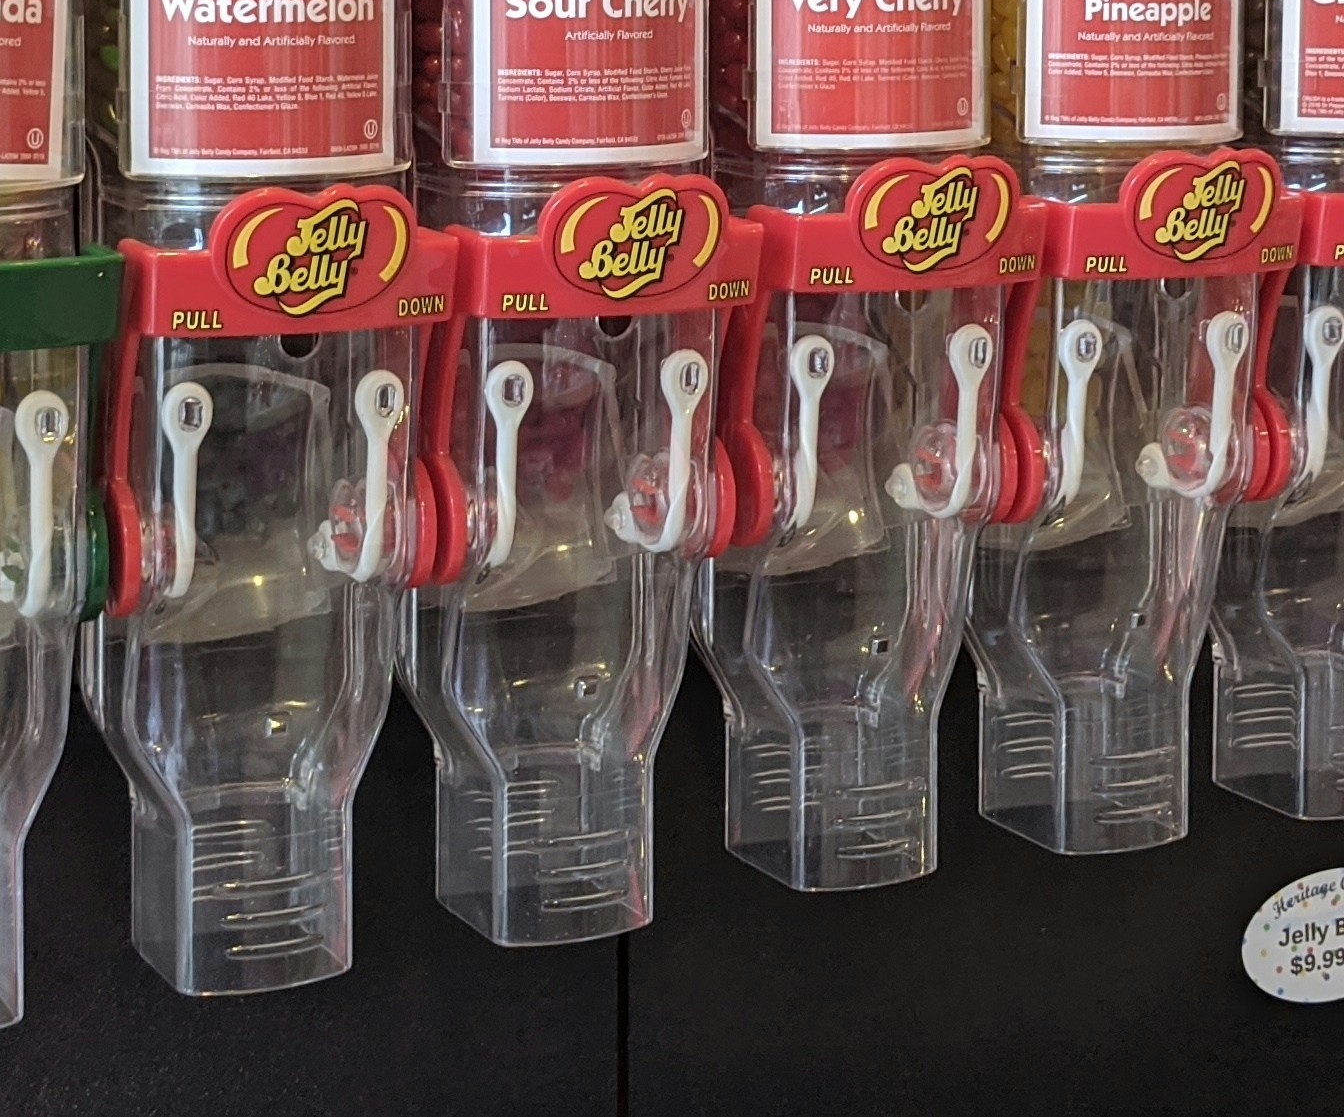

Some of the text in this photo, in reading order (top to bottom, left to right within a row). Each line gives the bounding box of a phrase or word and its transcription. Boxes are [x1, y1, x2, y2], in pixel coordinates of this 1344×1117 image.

[187, 34, 356, 47] Naturally and Artificially Flavored
[565, 29, 654, 41] Artificially Flavored
[808, 23, 852, 34] Naturally
[853, 23, 874, 33] and
[875, 22, 920, 34] Artificially
[1077, 31, 1120, 42] Naturally
[1122, 32, 1141, 42] and
[911, 166, 978, 226] Jelly
[1183, 160, 1247, 217] Jelly
[287, 199, 366, 259] Jelly
[609, 188, 684, 247] Jelly
[1155, 207, 1230, 262] Belly
[882, 216, 964, 273] Belly
[1085, 244, 1294, 273] PULL DOWN
[254, 252, 350, 316] Belly
[579, 241, 669, 299] Belly
[810, 254, 1035, 286] PULL DOWN
[172, 295, 445, 330] PULL DOWN
[502, 280, 750, 313] PULL DOWN
[1273, 880, 1336, 920] Heritage
[1278, 922, 1329, 948] Jelly
